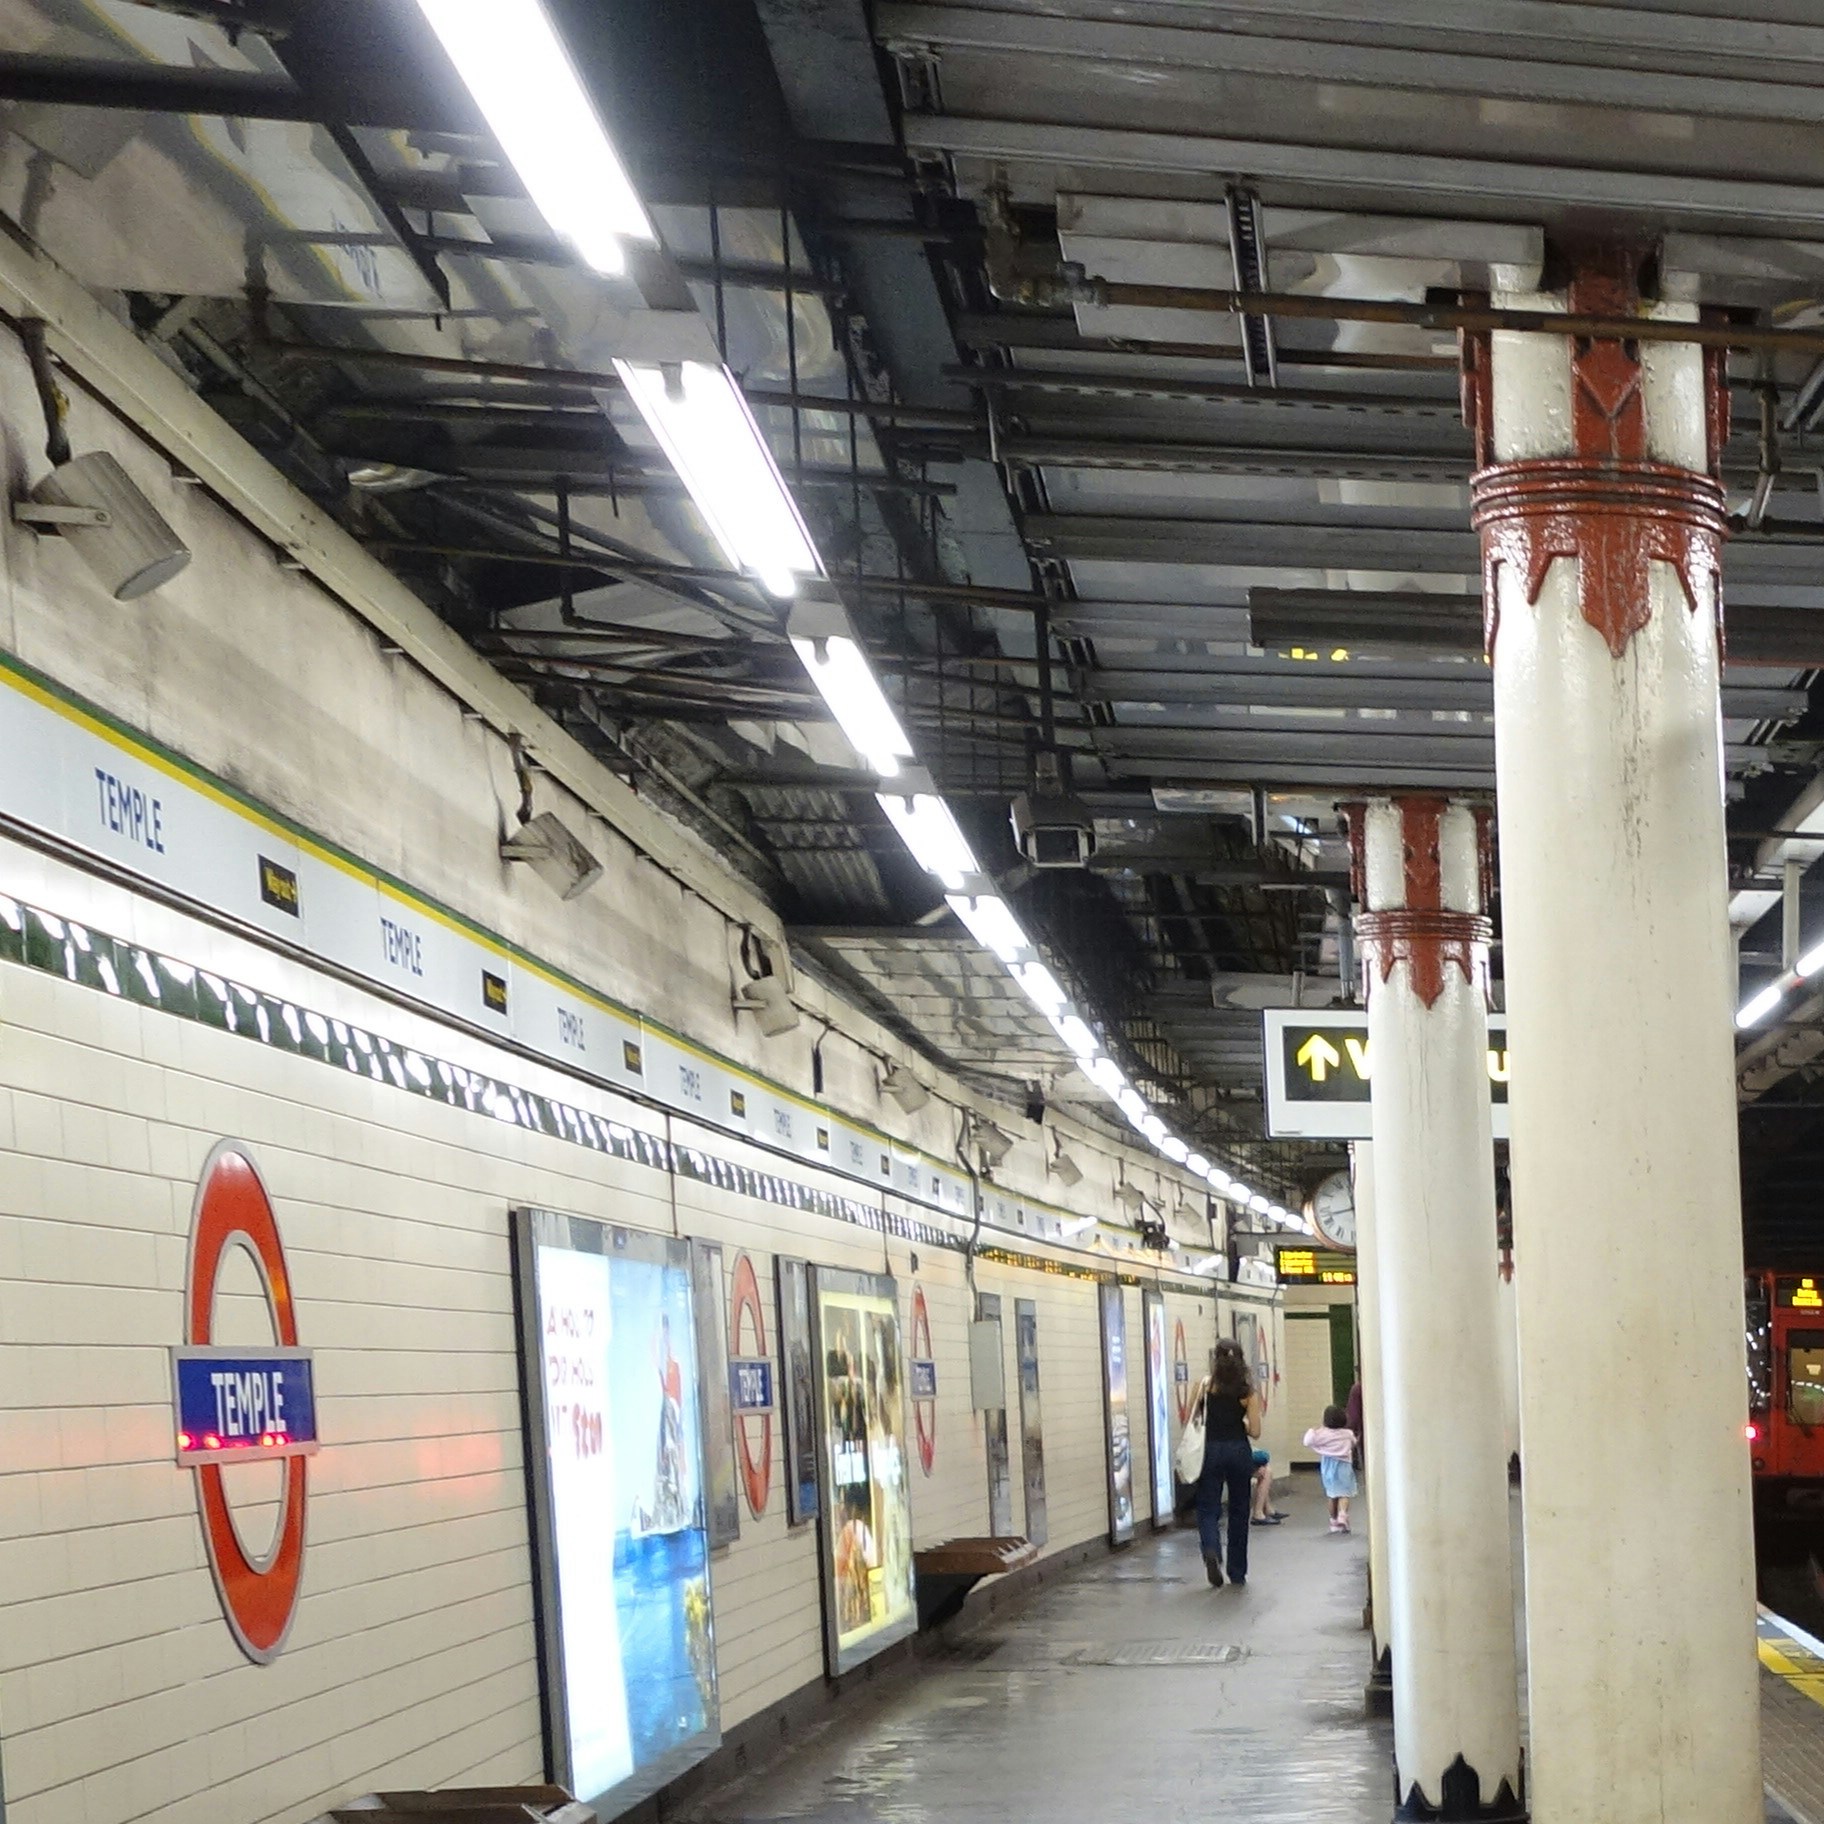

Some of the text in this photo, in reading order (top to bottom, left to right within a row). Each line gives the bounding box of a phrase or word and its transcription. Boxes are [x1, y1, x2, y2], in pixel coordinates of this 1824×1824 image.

[94, 766, 165, 855] TEMPLE
[379, 917, 423, 977] TEMPLE
[211, 1371, 287, 1437] TEMPLE
